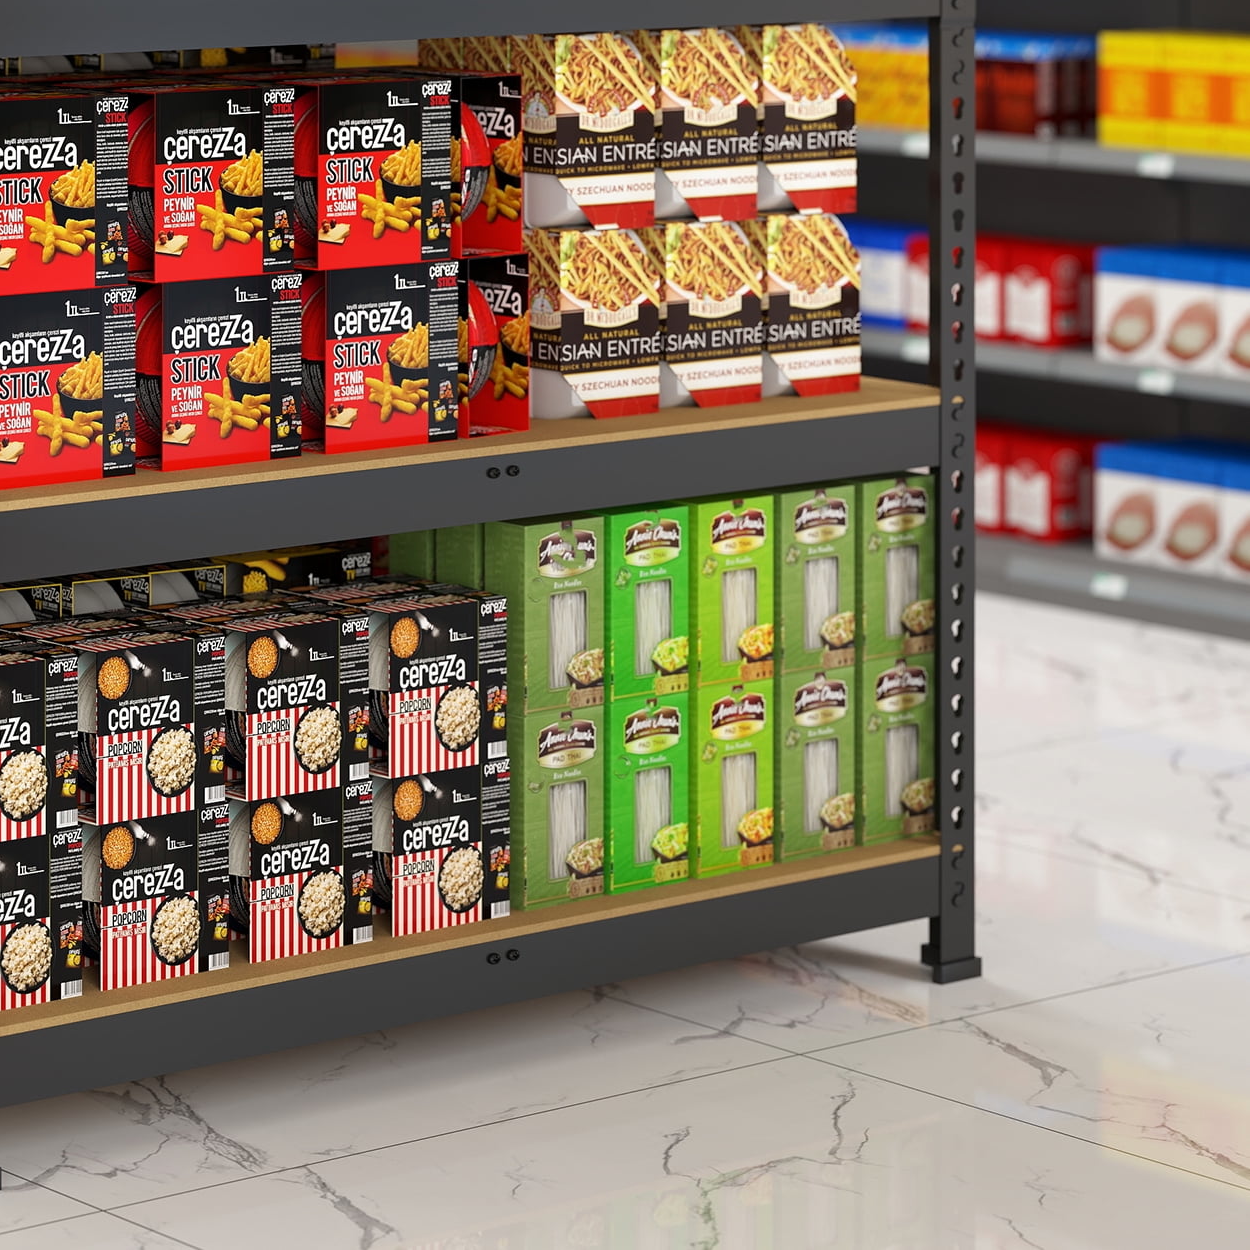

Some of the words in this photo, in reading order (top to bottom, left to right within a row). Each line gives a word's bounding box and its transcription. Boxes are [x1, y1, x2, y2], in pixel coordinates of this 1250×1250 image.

[597, 135, 634, 144] NATURAL
[684, 130, 698, 138] ALL
[702, 128, 738, 138] NATURAL
[662, 140, 702, 159] SIAN
[763, 132, 802, 152] SIAN
[556, 146, 596, 166] SIAN
[326, 156, 374, 184] STICK
[163, 166, 214, 195] STICK
[682, 177, 728, 189] SZECHUAN
[326, 185, 356, 201] PEYNİR
[577, 185, 624, 196] SZECHUAN
[164, 196, 194, 212] PEYNİR
[334, 201, 356, 212] SOĞAN
[164, 216, 170, 224] VE
[171, 211, 195, 224] SOĞAN
[583, 333, 598, 341] ALL
[602, 329, 639, 340] NATURAL
[334, 340, 382, 368] STICK
[560, 342, 602, 362] SIAN
[170, 354, 222, 384] STICK
[334, 370, 364, 386] PEYNİR
[582, 380, 628, 390] SZECHUAN
[171, 384, 202, 400] PEYNİR
[342, 384, 364, 396] SOĞAN
[172, 404, 178, 412] VE
[179, 400, 202, 412] SOĞAN
[6, 417, 32, 429] SOĞAN
[400, 698, 432, 713] POPCORN
[257, 718, 290, 734] POPCORN
[108, 740, 143, 756] POPCORN
[403, 859, 435, 875] POPCORN
[261, 884, 294, 900] POPCORN
[112, 910, 147, 927] POPCORN
